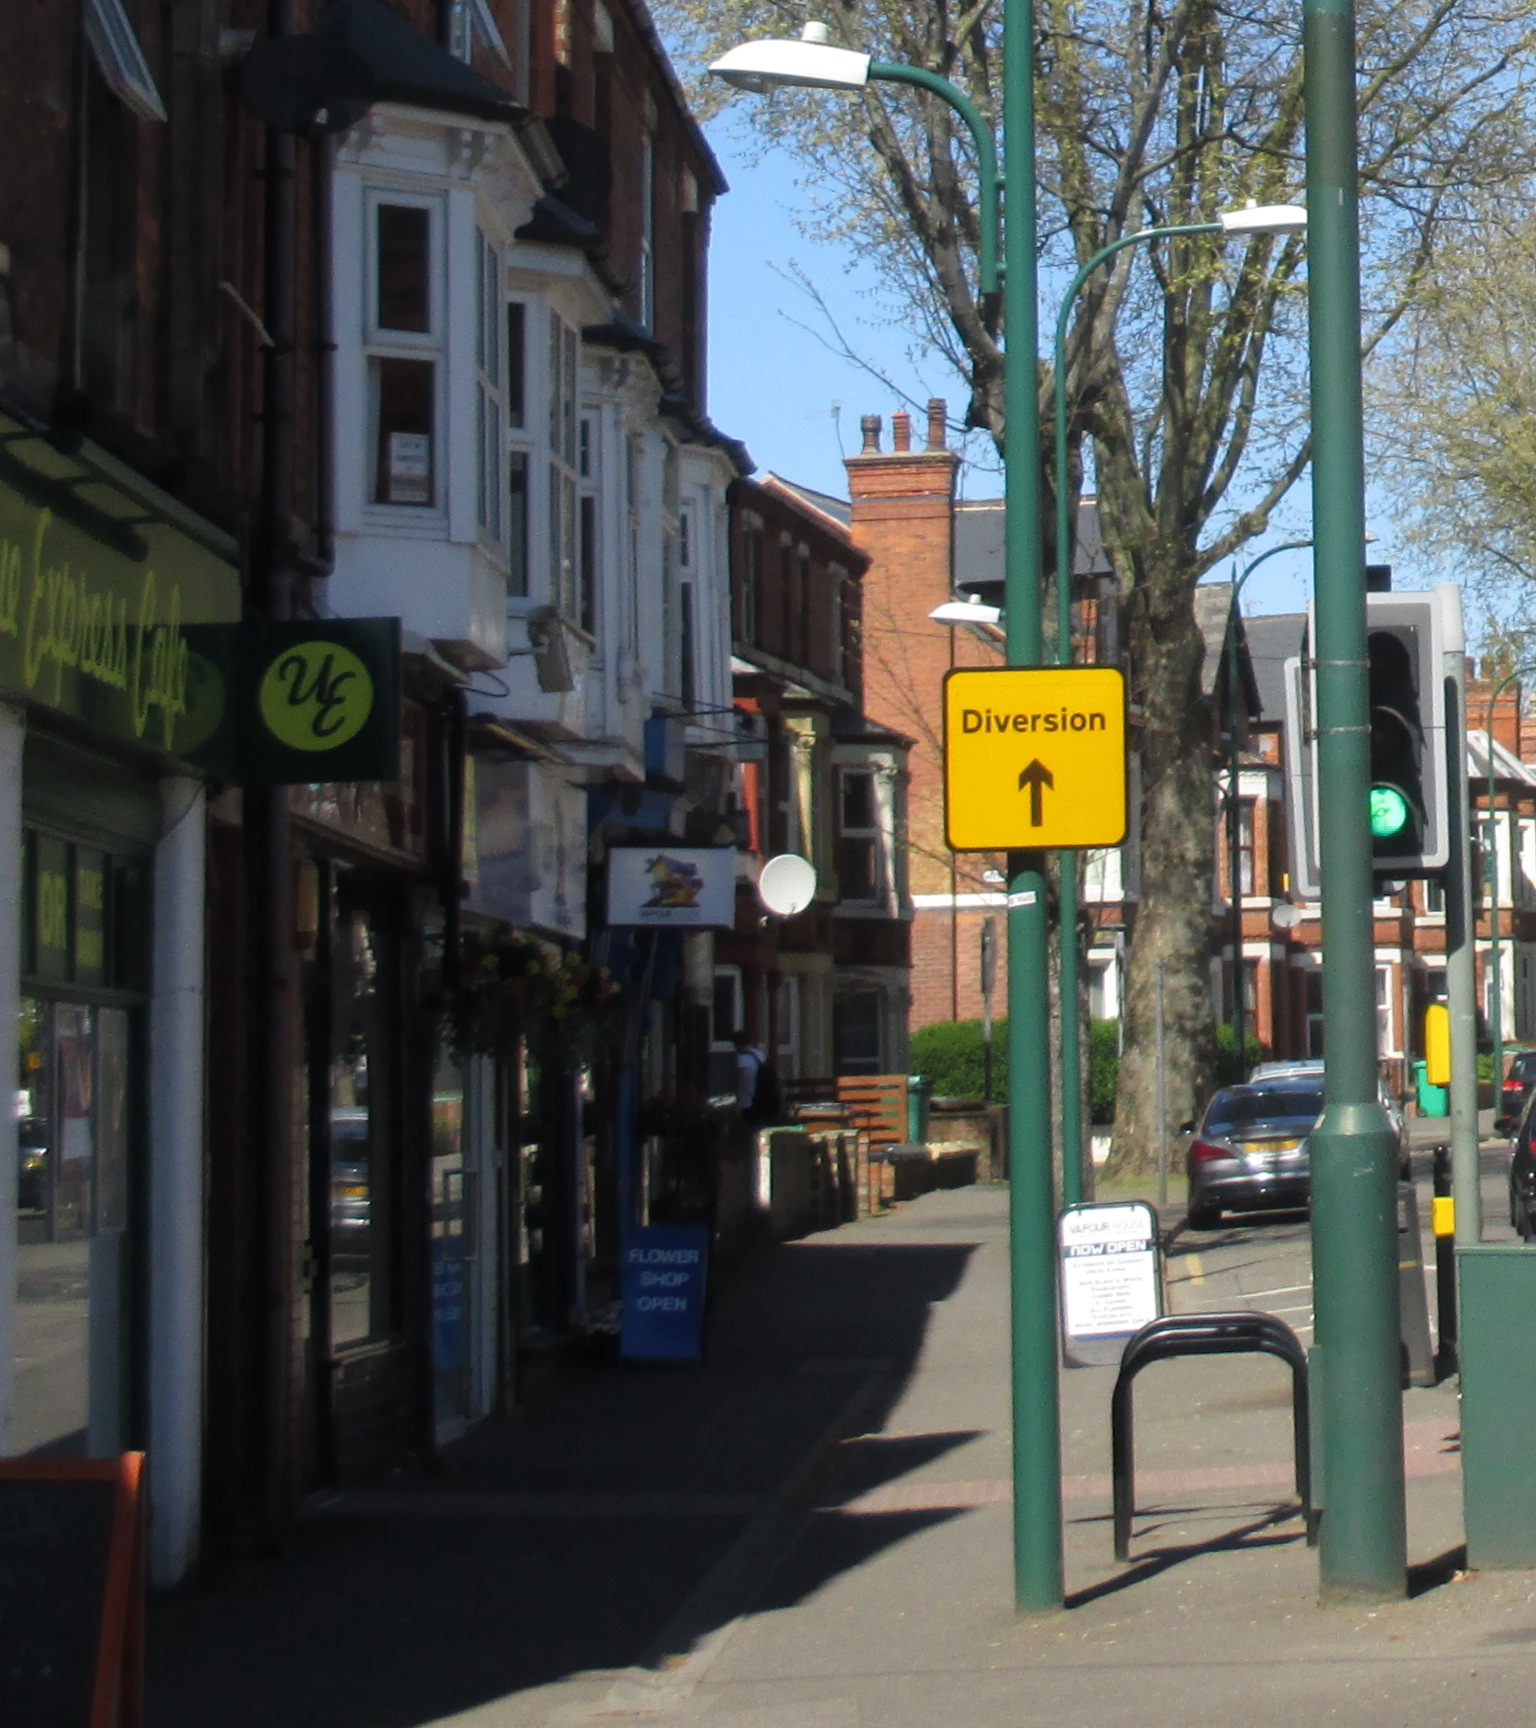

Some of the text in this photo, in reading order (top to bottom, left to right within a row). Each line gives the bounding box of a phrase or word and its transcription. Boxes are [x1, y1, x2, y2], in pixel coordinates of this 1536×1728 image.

[962, 707, 1106, 734] Diversion
[1069, 1218, 1145, 1234] VAPOUR HOUSE
[1106, 1239, 1147, 1254] OPEN
[628, 1248, 700, 1264] FLOWER
[640, 1272, 690, 1287] SHOP
[637, 1296, 688, 1311] OPEN
